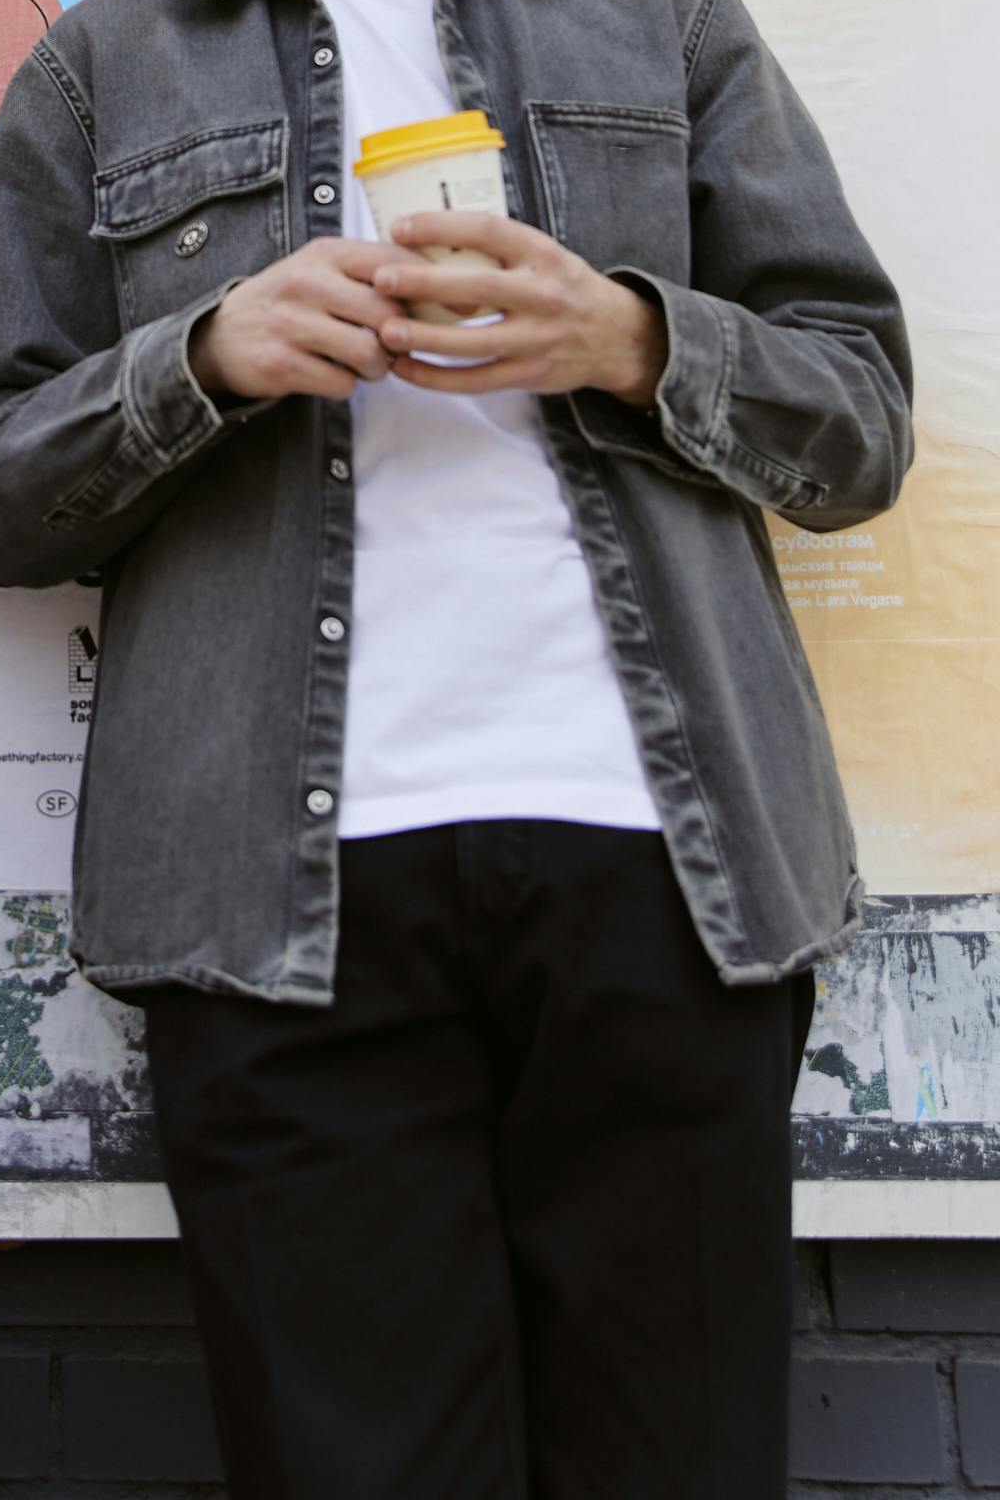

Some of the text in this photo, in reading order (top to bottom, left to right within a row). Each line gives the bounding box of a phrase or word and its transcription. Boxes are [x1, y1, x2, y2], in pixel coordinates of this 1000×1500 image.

[838, 560, 884, 574] танцы
[804, 578, 858, 591] музыка
[46, 796, 68, 812] SF
